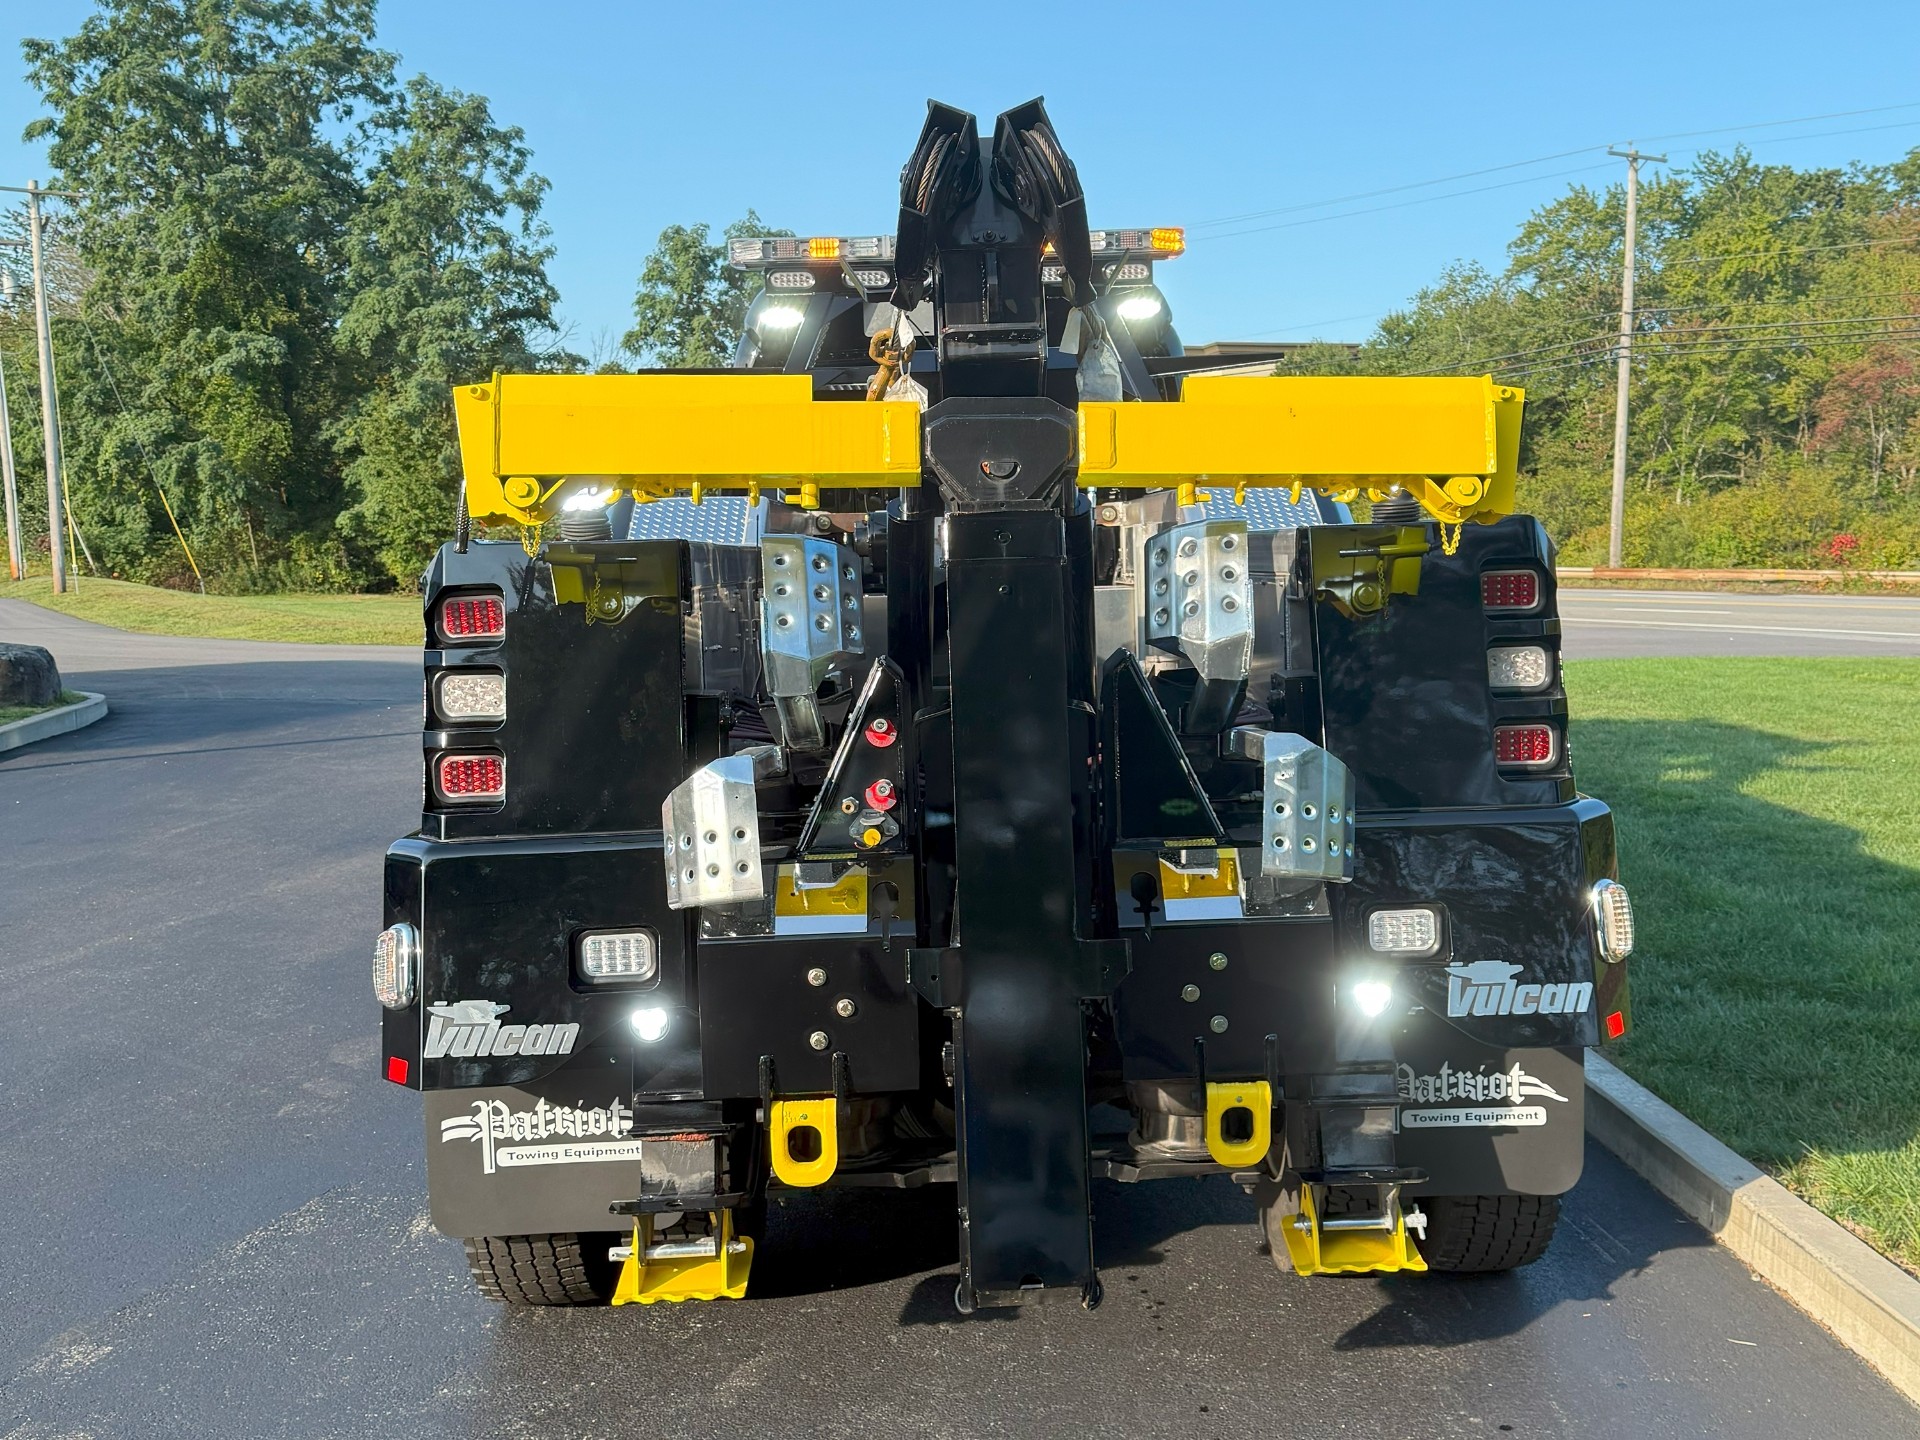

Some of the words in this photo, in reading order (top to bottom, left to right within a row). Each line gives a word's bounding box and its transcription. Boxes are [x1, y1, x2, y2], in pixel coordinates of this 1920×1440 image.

[1411, 1112, 1460, 1123] Towing
[1465, 1110, 1539, 1122] Equipment
[470, 1096, 633, 1174] Patriot
[506, 1150, 559, 1162] Towing
[564, 1145, 641, 1158] Equipment
